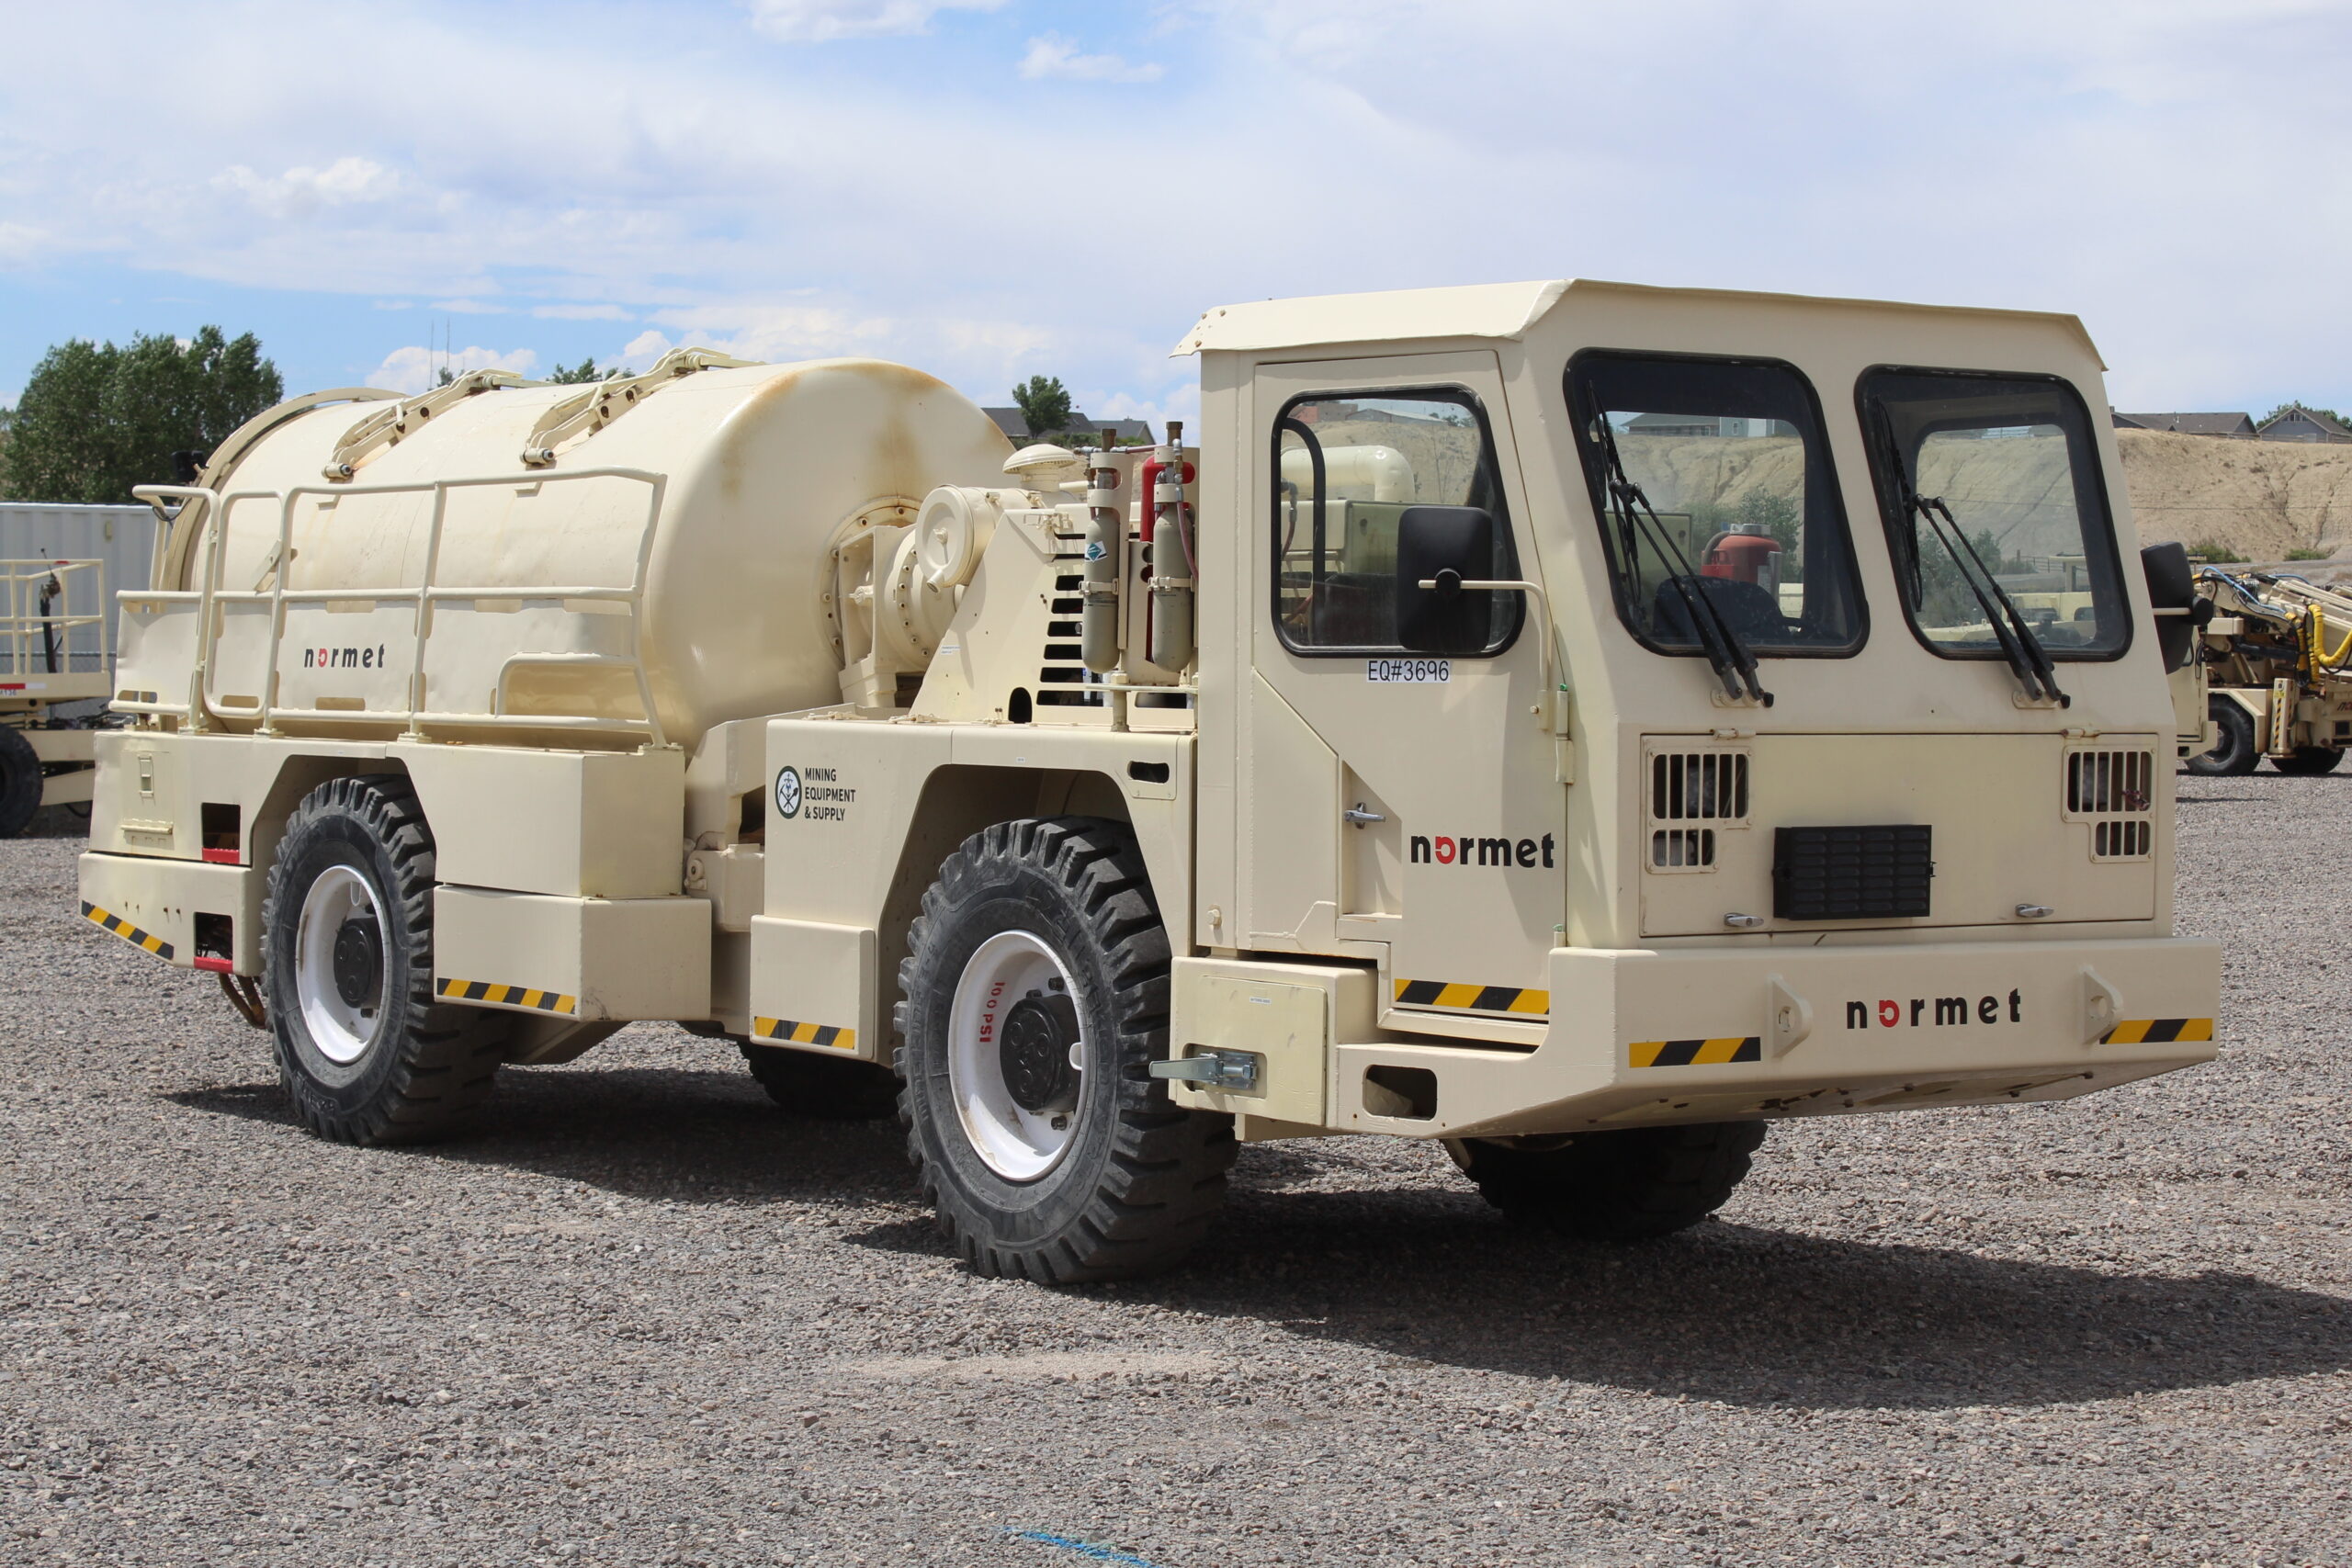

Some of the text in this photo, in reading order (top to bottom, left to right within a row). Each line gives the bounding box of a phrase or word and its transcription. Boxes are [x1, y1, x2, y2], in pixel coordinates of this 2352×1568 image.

[304, 643, 384, 668] normet
[1368, 660, 1449, 682] EQ#3696
[805, 767, 837, 782] MINING
[805, 786, 856, 802] EQUIPMENT
[804, 806, 845, 821] & SUPPLY
[1411, 832, 1555, 869] normet
[1847, 987, 2021, 1029] normet
[979, 1013, 993, 1043] PSI
